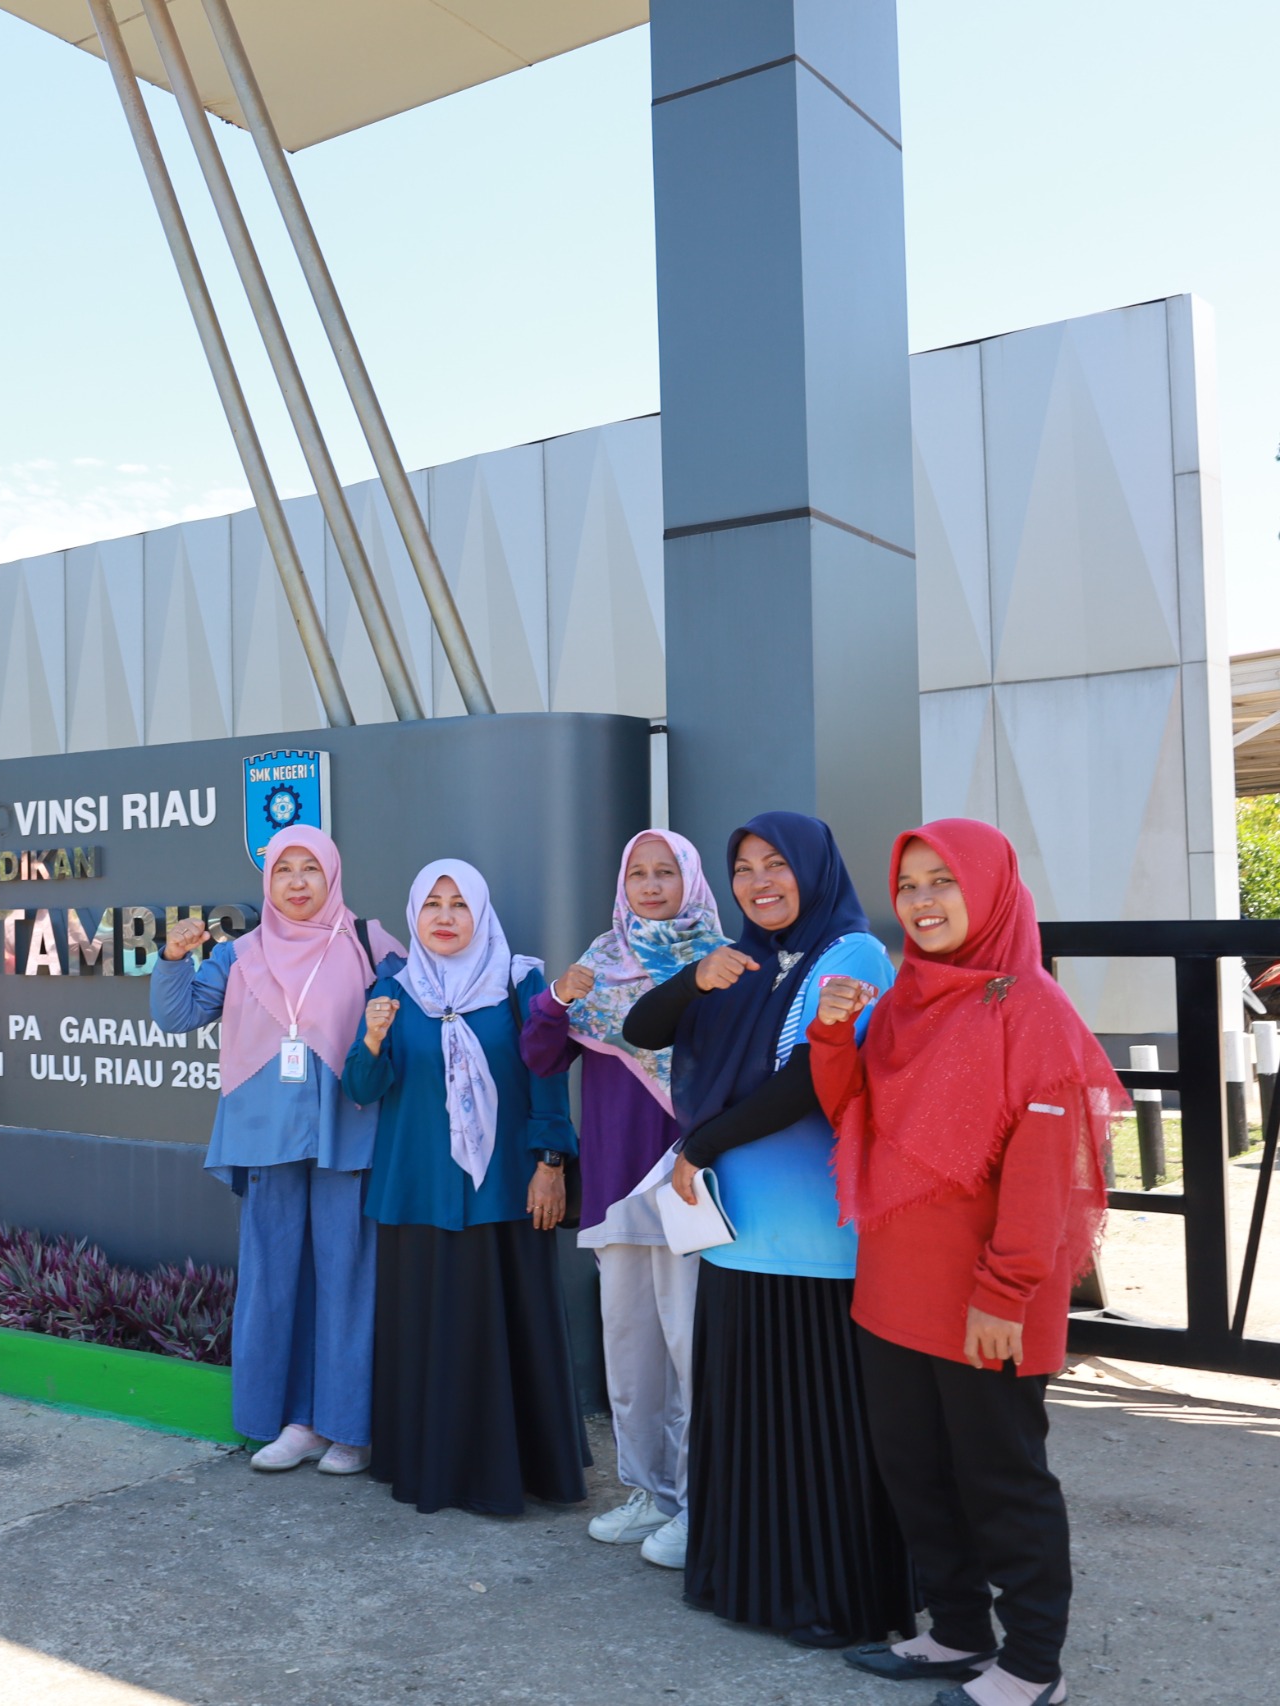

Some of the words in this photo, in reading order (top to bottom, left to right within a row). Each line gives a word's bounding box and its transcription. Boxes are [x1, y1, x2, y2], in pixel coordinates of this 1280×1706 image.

[250, 767, 271, 782] SMK
[273, 764, 307, 781] NEGERI
[309, 763, 316, 778] 1
[122, 786, 217, 831] RIAU
[30, 1053, 87, 1087] ULU,
[94, 1056, 164, 1088] RIAU
